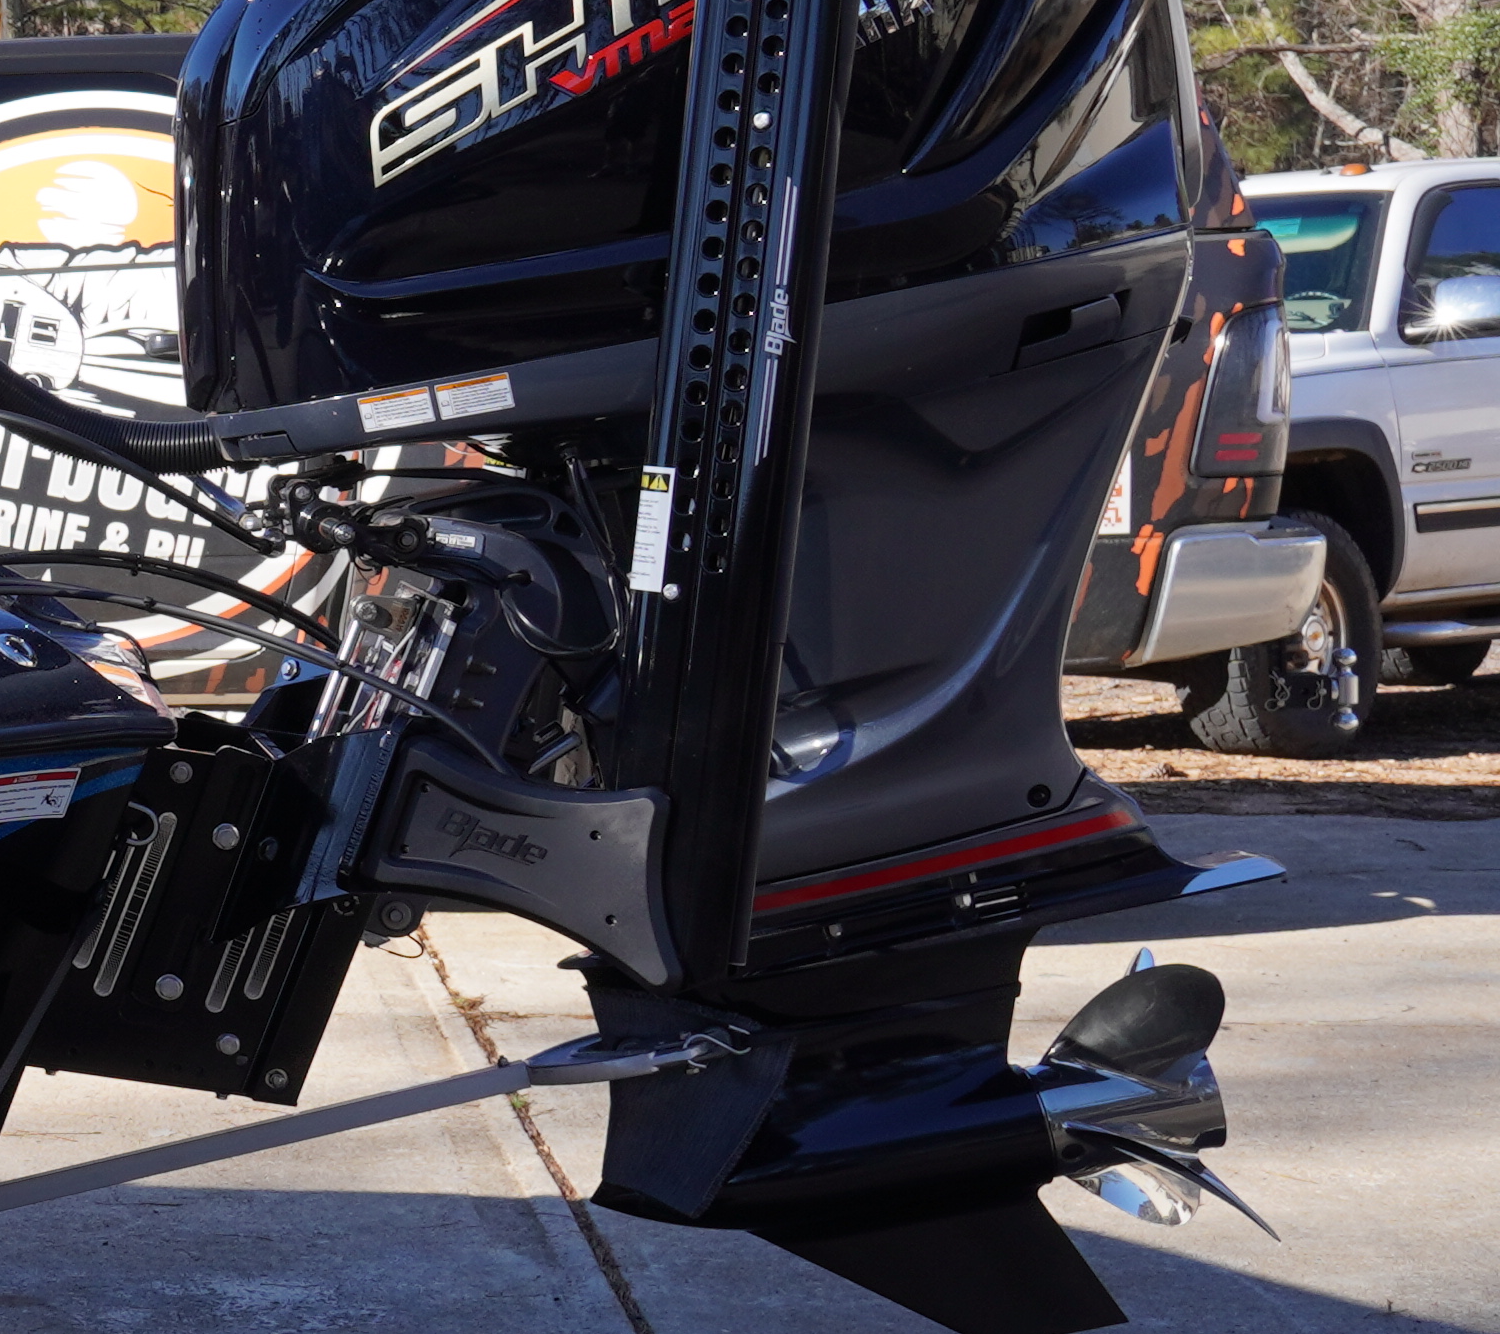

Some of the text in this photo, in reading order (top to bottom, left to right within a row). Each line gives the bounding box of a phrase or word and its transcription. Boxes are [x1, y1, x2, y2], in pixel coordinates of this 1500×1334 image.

[764, 288, 797, 356] Blade
[98, 521, 130, 554] &
[436, 805, 548, 865] Blade
